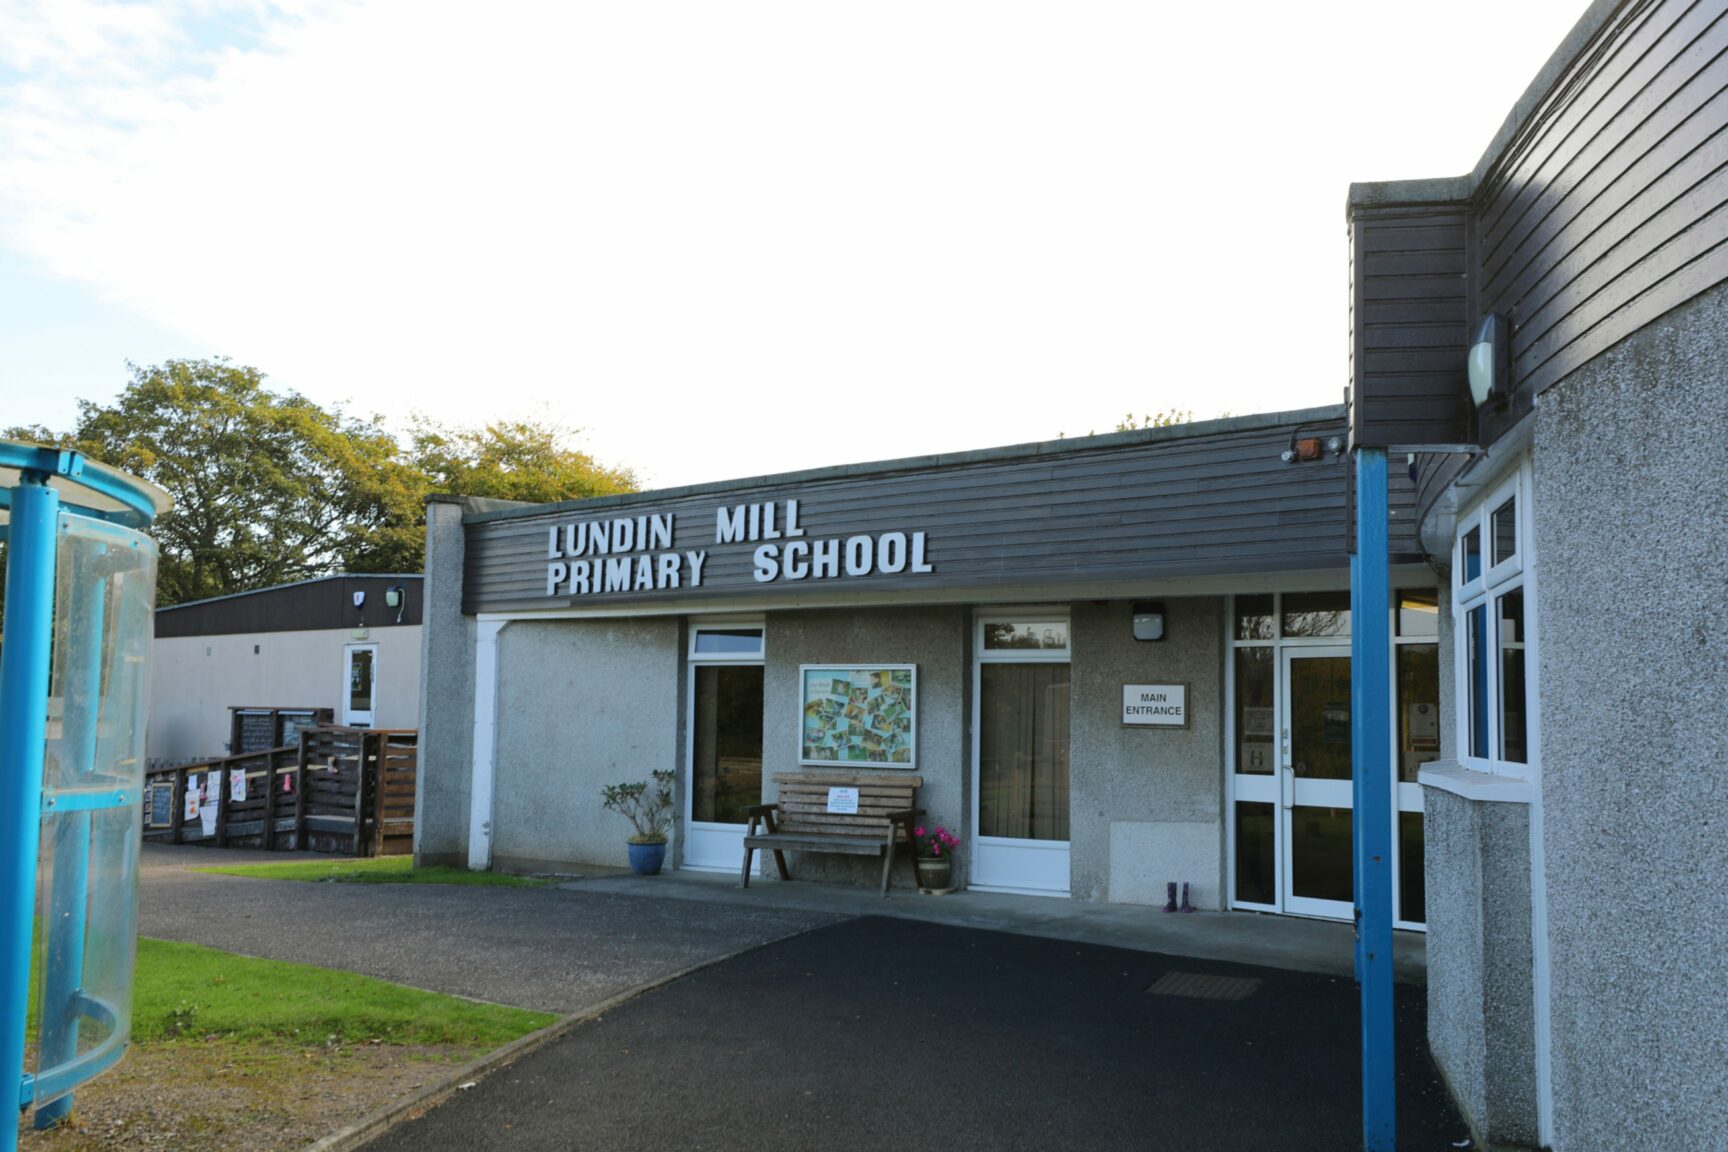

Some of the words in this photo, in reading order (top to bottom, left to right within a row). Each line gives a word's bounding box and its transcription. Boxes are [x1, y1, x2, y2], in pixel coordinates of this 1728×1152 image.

[548, 512, 674, 558] LUNDIN
[716, 499, 804, 544] MILL
[547, 549, 706, 595] PRIMARY
[753, 531, 932, 583] SCHOOL
[1125, 706, 1182, 716] ENTRANCE
[1140, 693, 1167, 702] MAIN
